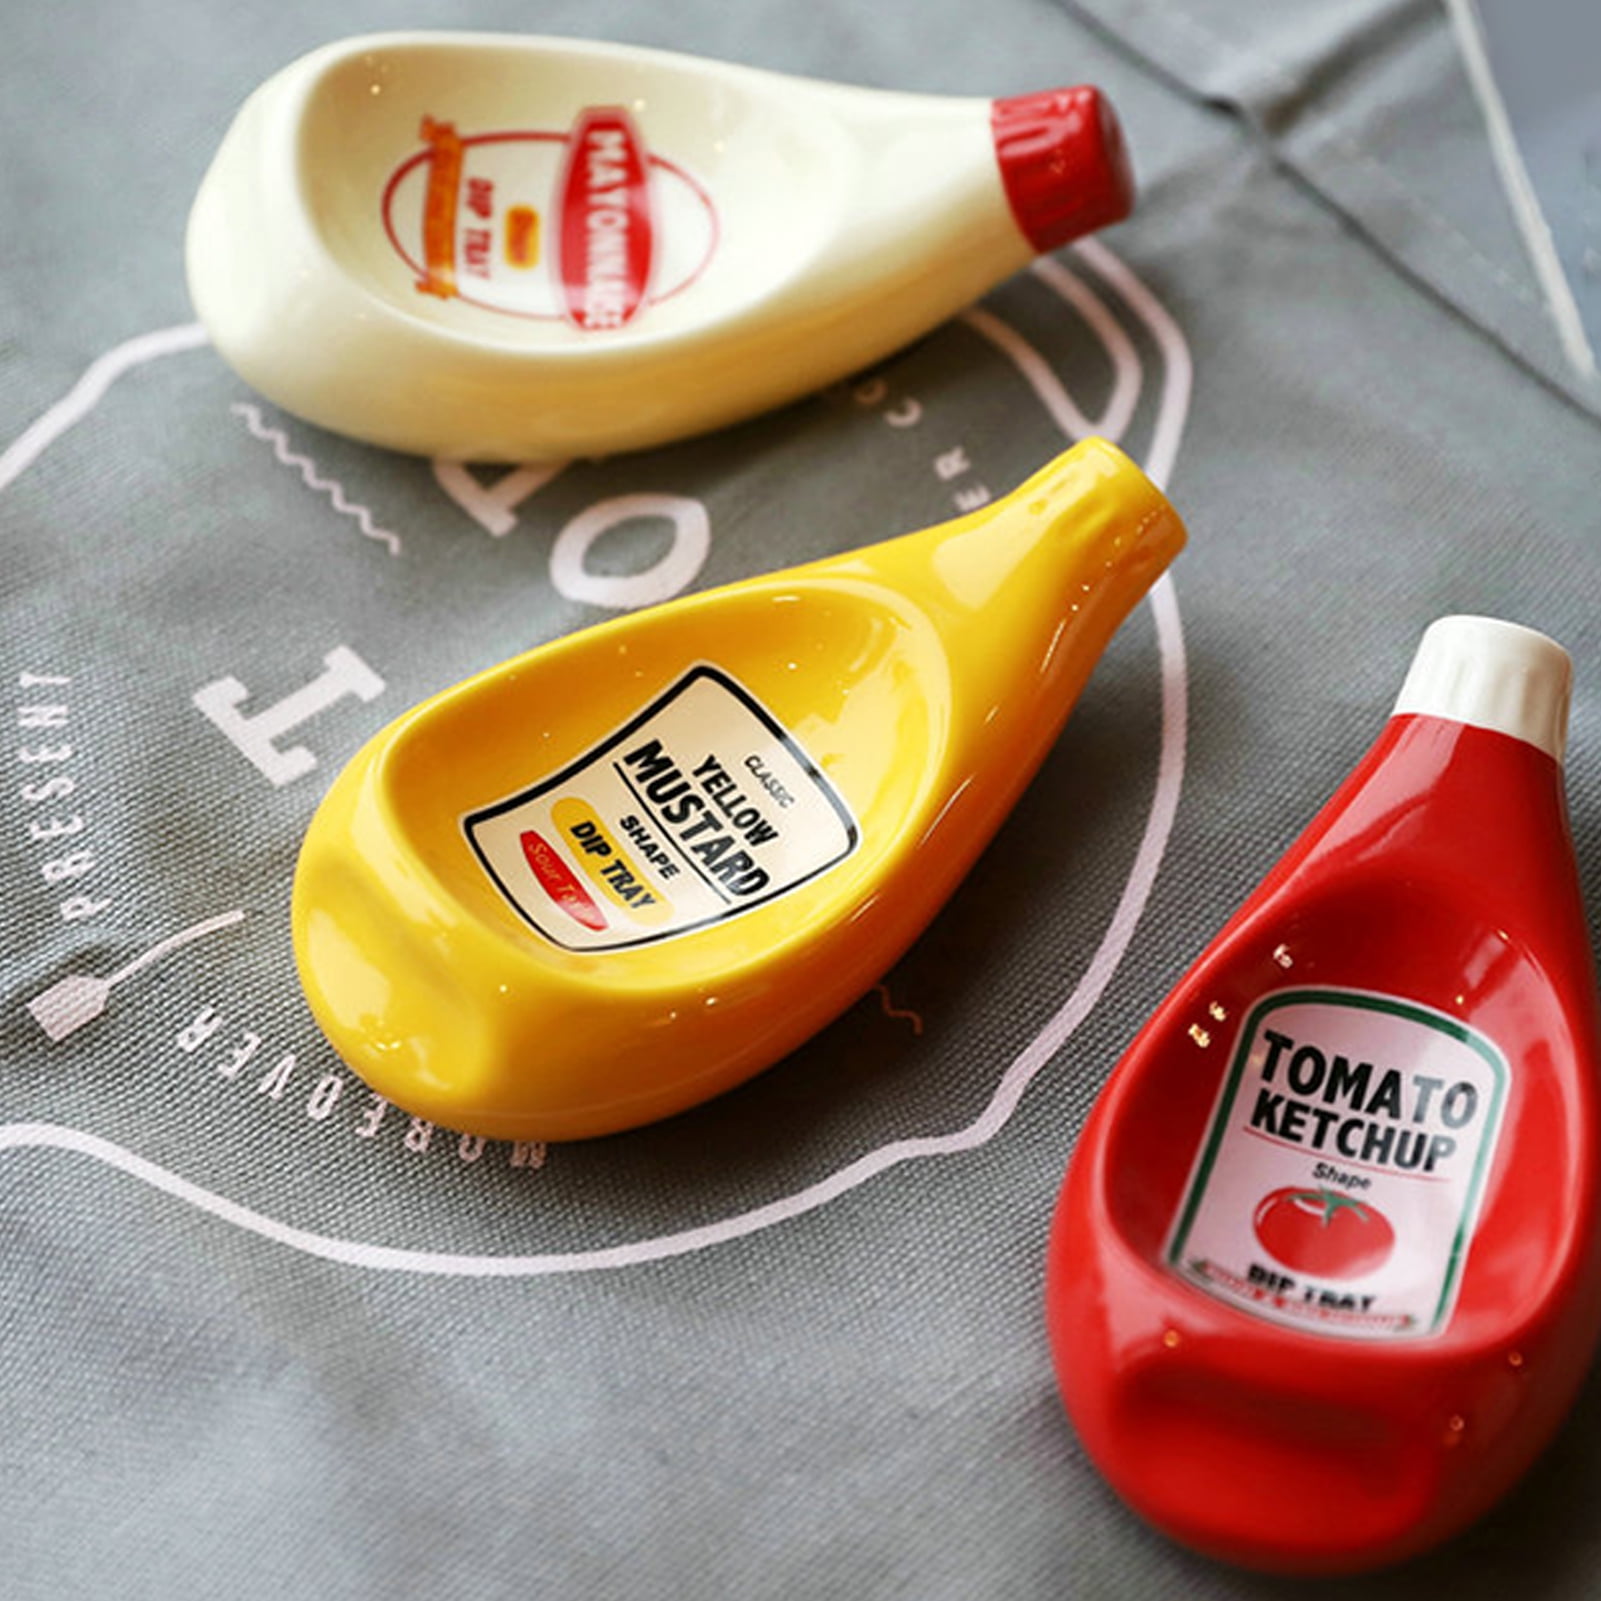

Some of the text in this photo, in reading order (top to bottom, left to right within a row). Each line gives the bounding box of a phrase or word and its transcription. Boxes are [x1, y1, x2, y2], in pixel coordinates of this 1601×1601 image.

[623, 738, 770, 898] MUSTARD
[692, 754, 779, 848] YELLOW
[743, 755, 795, 809] CLASSIC
[570, 820, 612, 858] DIP
[600, 859, 656, 910] TRAY
[620, 814, 681, 881] SHAPE
[1259, 1029, 1480, 1131] TOMATO
[1250, 1087, 1457, 1173] KETCHUP
[1312, 1161, 1373, 1191] Shape
[1246, 1263, 1297, 1295] DIP
